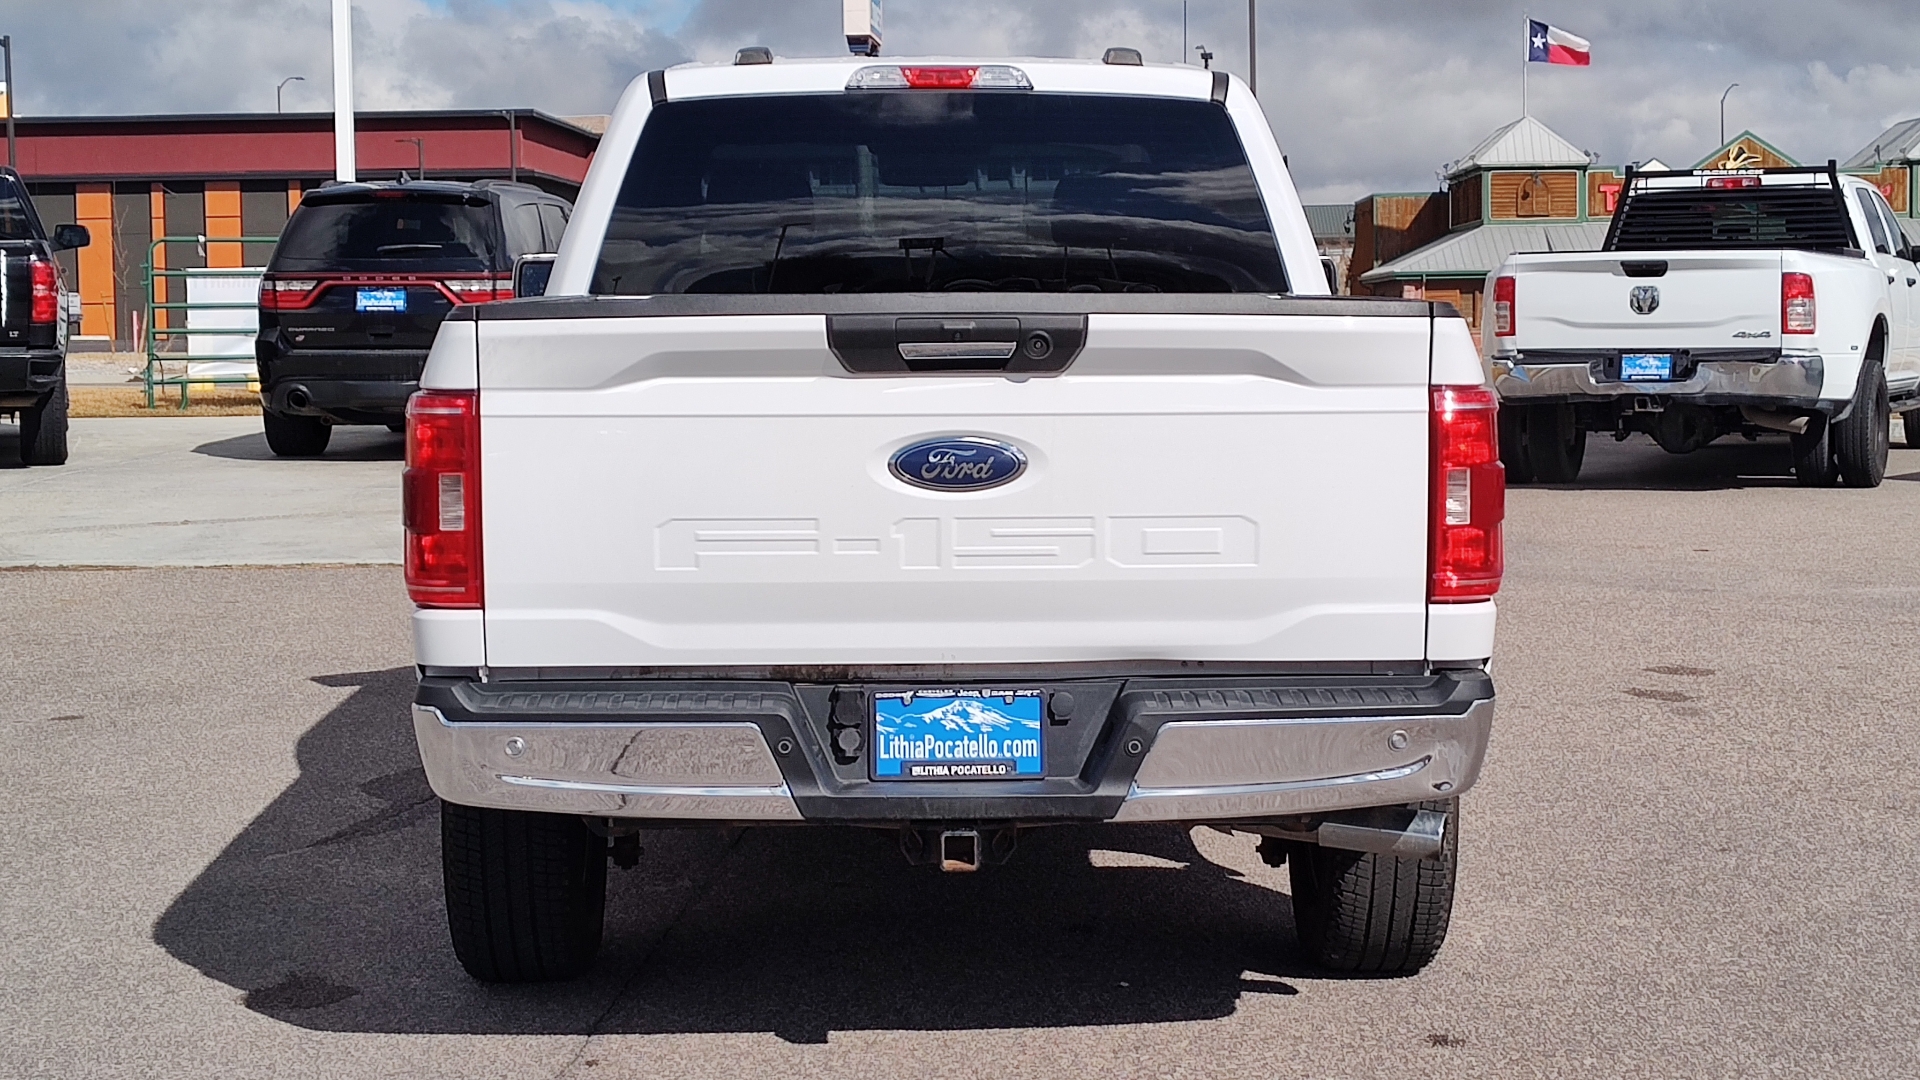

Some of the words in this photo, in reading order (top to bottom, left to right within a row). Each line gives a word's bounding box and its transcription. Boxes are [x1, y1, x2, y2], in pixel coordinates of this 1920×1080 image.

[921, 448, 995, 479] Ford
[654, 515, 1260, 571] F-150
[879, 733, 1038, 759] LithiaPocatello.com
[951, 764, 1007, 775] POCATELLO
